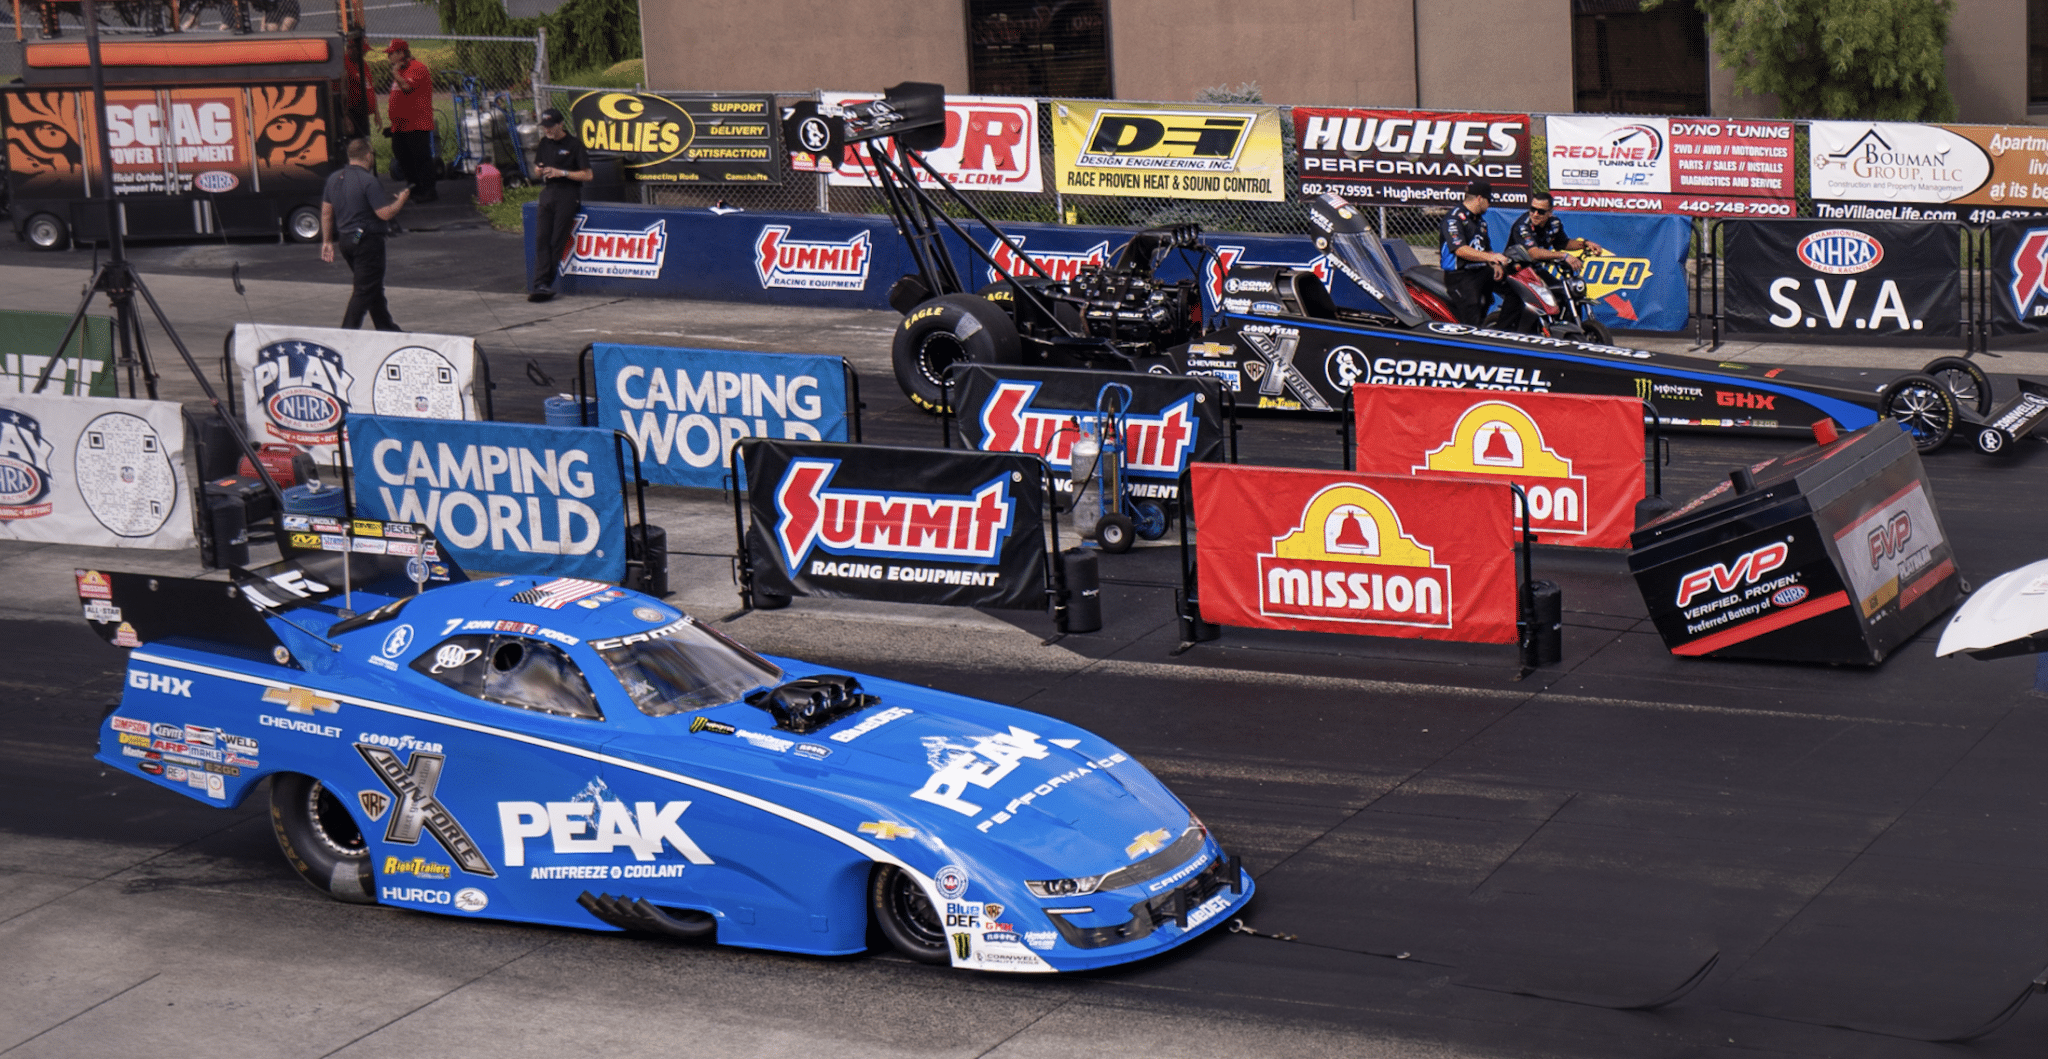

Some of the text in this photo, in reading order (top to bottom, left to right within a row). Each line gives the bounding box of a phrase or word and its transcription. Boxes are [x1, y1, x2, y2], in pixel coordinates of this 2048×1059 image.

[711, 103, 764, 113] SUPPORT
[783, 108, 796, 120] 7
[107, 103, 232, 147] SCAG
[710, 125, 764, 136] DELIVERY
[1671, 123, 1790, 139] DYNO TUNING
[582, 119, 680, 154] CALLIES
[1304, 116, 1523, 157] HUGHES
[156, 146, 234, 163] EUIPMENT
[688, 148, 767, 159] SATISFACTION
[1553, 145, 1646, 160] REDLINE
[1674, 144, 1693, 154] 2WD
[1702, 145, 1721, 155] AWD
[1080, 156, 1123, 167] DESIGN
[1209, 161, 1233, 170] INC.
[1304, 158, 1523, 179] PERFORMANCE
[1598, 160, 1634, 168] TUNING
[1679, 160, 1703, 170] PARTS
[1713, 161, 1737, 171] SALES
[1747, 162, 1783, 173] INSTALLS
[136, 172, 164, 183] Outdoo
[200, 174, 235, 189] NHRA
[679, 173, 699, 181] Rods
[1562, 169, 1598, 178] COBB
[1623, 173, 1646, 185] HP
[1680, 175, 1782, 189] DIAGNOSTICS AND SERVICE
[1932, 168, 1963, 182] LLC
[113, 184, 149, 195] quipment
[1067, 171, 1272, 194] RACE PROVEN HEAT & SOUND CONTROL
[1828, 180, 1872, 189] Construction
[1887, 182, 1917, 191] Property
[1918, 184, 1964, 192] Management
[1990, 182, 2006, 198] at
[2008, 181, 2028, 198] its
[1302, 183, 1374, 198] 602.257.9591
[1384, 186, 1528, 203] HughesPerfore.com
[1553, 196, 1791, 215] RLTUNING.COM 440-748-7000
[1817, 203, 1958, 220] TheVillageLife.com
[1810, 229, 1868, 241] CHAMPIONSHIP
[1811, 237, 1871, 266] NHRA
[606, 267, 657, 277] EQUIPMENT
[1812, 261, 1868, 274] DRAG RACING
[774, 278, 862, 289] RACING EQUIPMENT
[1769, 276, 1924, 330] S.V.A.
[904, 307, 944, 331] EAGLE
[1243, 324, 1300, 337] GOODYEAR
[1187, 359, 1238, 369] CHEVROLET
[1255, 338, 1287, 370] JOHN
[1281, 365, 1321, 406] FORCE
[1374, 357, 1547, 387] CORNWELL
[254, 353, 348, 408] PLAY
[617, 364, 823, 422] CAMPING
[1653, 384, 1703, 397] MONSTER
[284, 395, 330, 421] NHRA
[1716, 390, 1777, 410] GHX
[373, 438, 596, 499] CAMPING
[379, 486, 601, 557] WORLD
[384, 522, 415, 535] JESEL
[1867, 509, 1912, 571] FVP
[811, 560, 1000, 588] RACING EQUIPMENT
[1676, 542, 1789, 608] FVP
[1269, 566, 1442, 615] MISSION
[1684, 573, 1799, 620] VERIFIED. PROVEN.
[1687, 586, 1807, 635] Preferred Battery of NHRA
[440, 617, 464, 636] 7
[462, 620, 496, 631] JOHN
[537, 628, 580, 646] FORCE
[437, 644, 467, 665] AAA
[129, 669, 194, 698] GHX
[114, 718, 149, 733] SIMPSON
[259, 714, 343, 738] CHEVROLET
[153, 740, 190, 753] ARP
[225, 733, 259, 749] WELD
[359, 732, 444, 753] GOODYEAR
[190, 746, 222, 761] MAHLE
[909, 725, 1051, 818] PEAK
[375, 755, 479, 866] JOHN FORCE
[497, 800, 717, 867] PEAK
[531, 863, 686, 880] ANTIFREEZE COOLANT
[1149, 853, 1208, 892] CAMARO
[382, 886, 452, 905] HURCO
[946, 902, 980, 916] Blue
[946, 914, 979, 928] DEF
[986, 953, 1038, 962] CORNWELL
